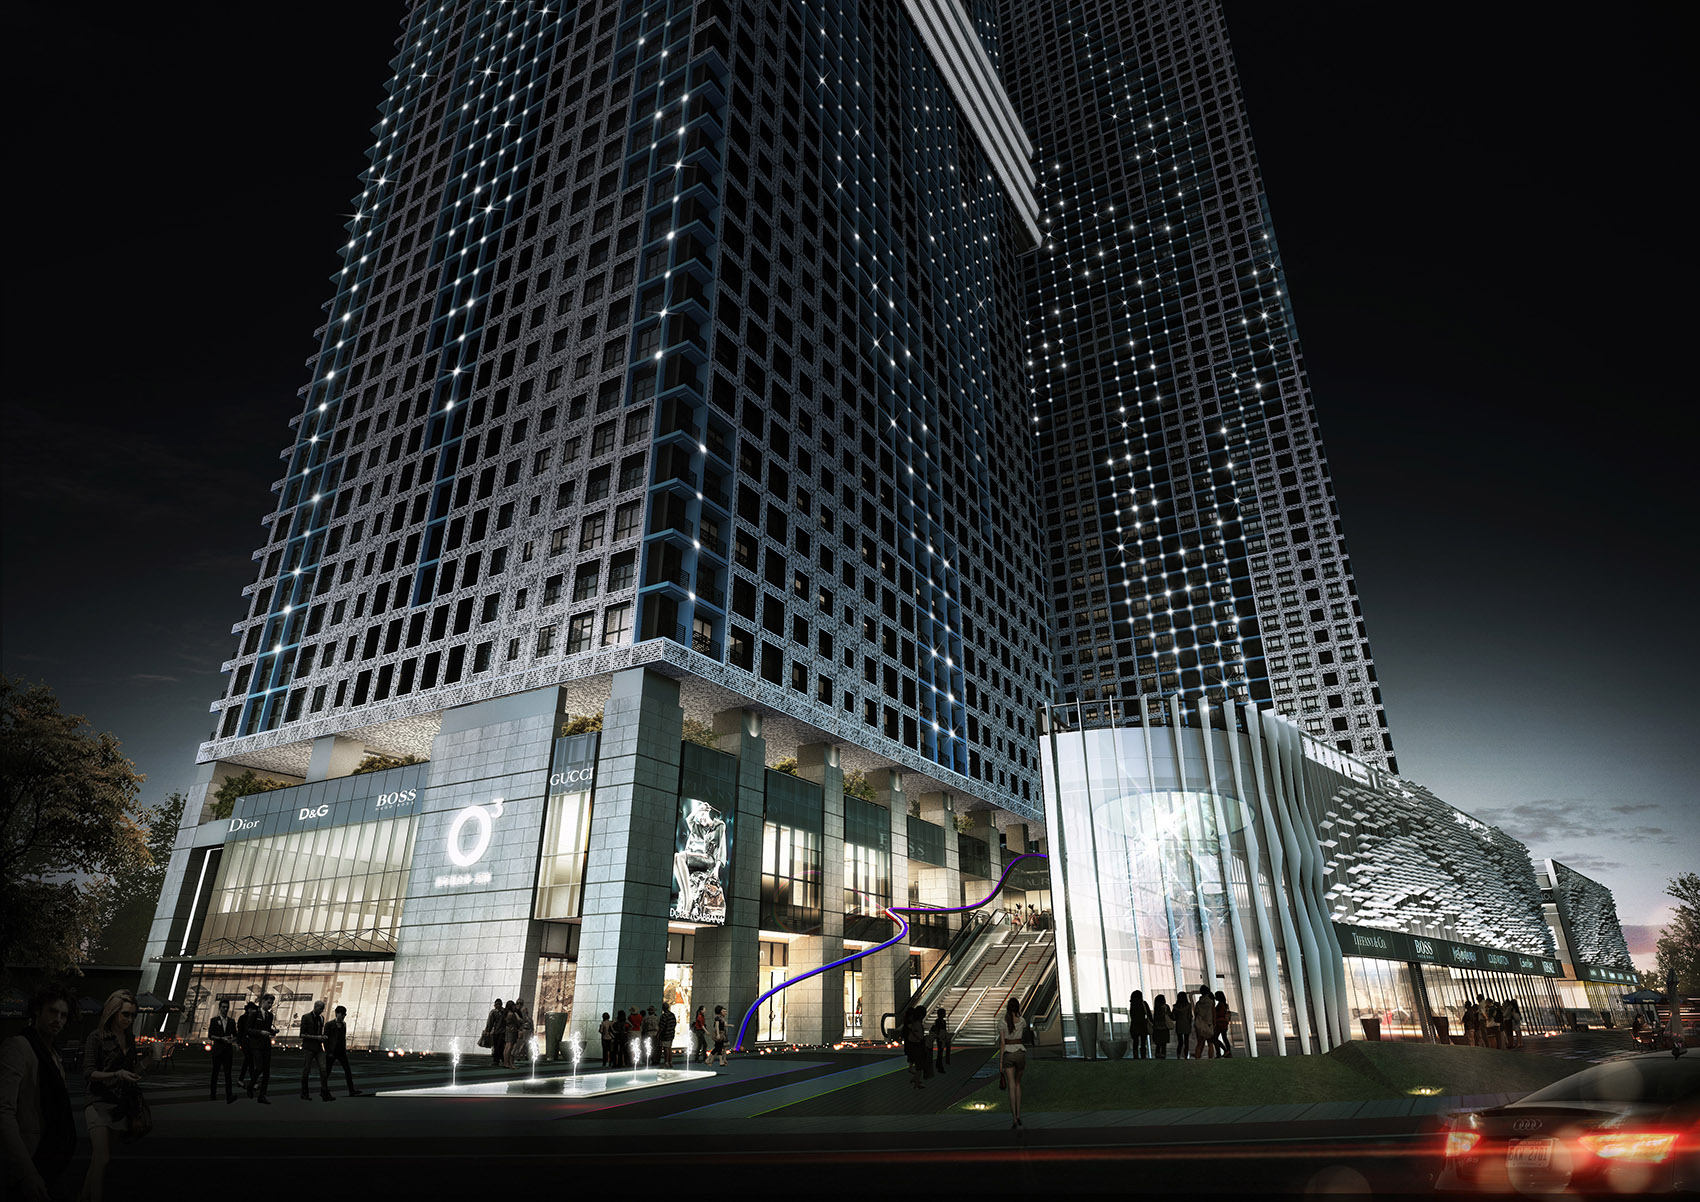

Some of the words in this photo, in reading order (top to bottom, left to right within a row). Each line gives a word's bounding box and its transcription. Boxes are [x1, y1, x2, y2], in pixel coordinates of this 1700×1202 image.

[550, 767, 594, 786] GUCCI
[375, 788, 417, 807] BOSS
[298, 804, 329, 821] D&G
[228, 818, 260, 832] Dior
[1414, 939, 1434, 955] BOSS
